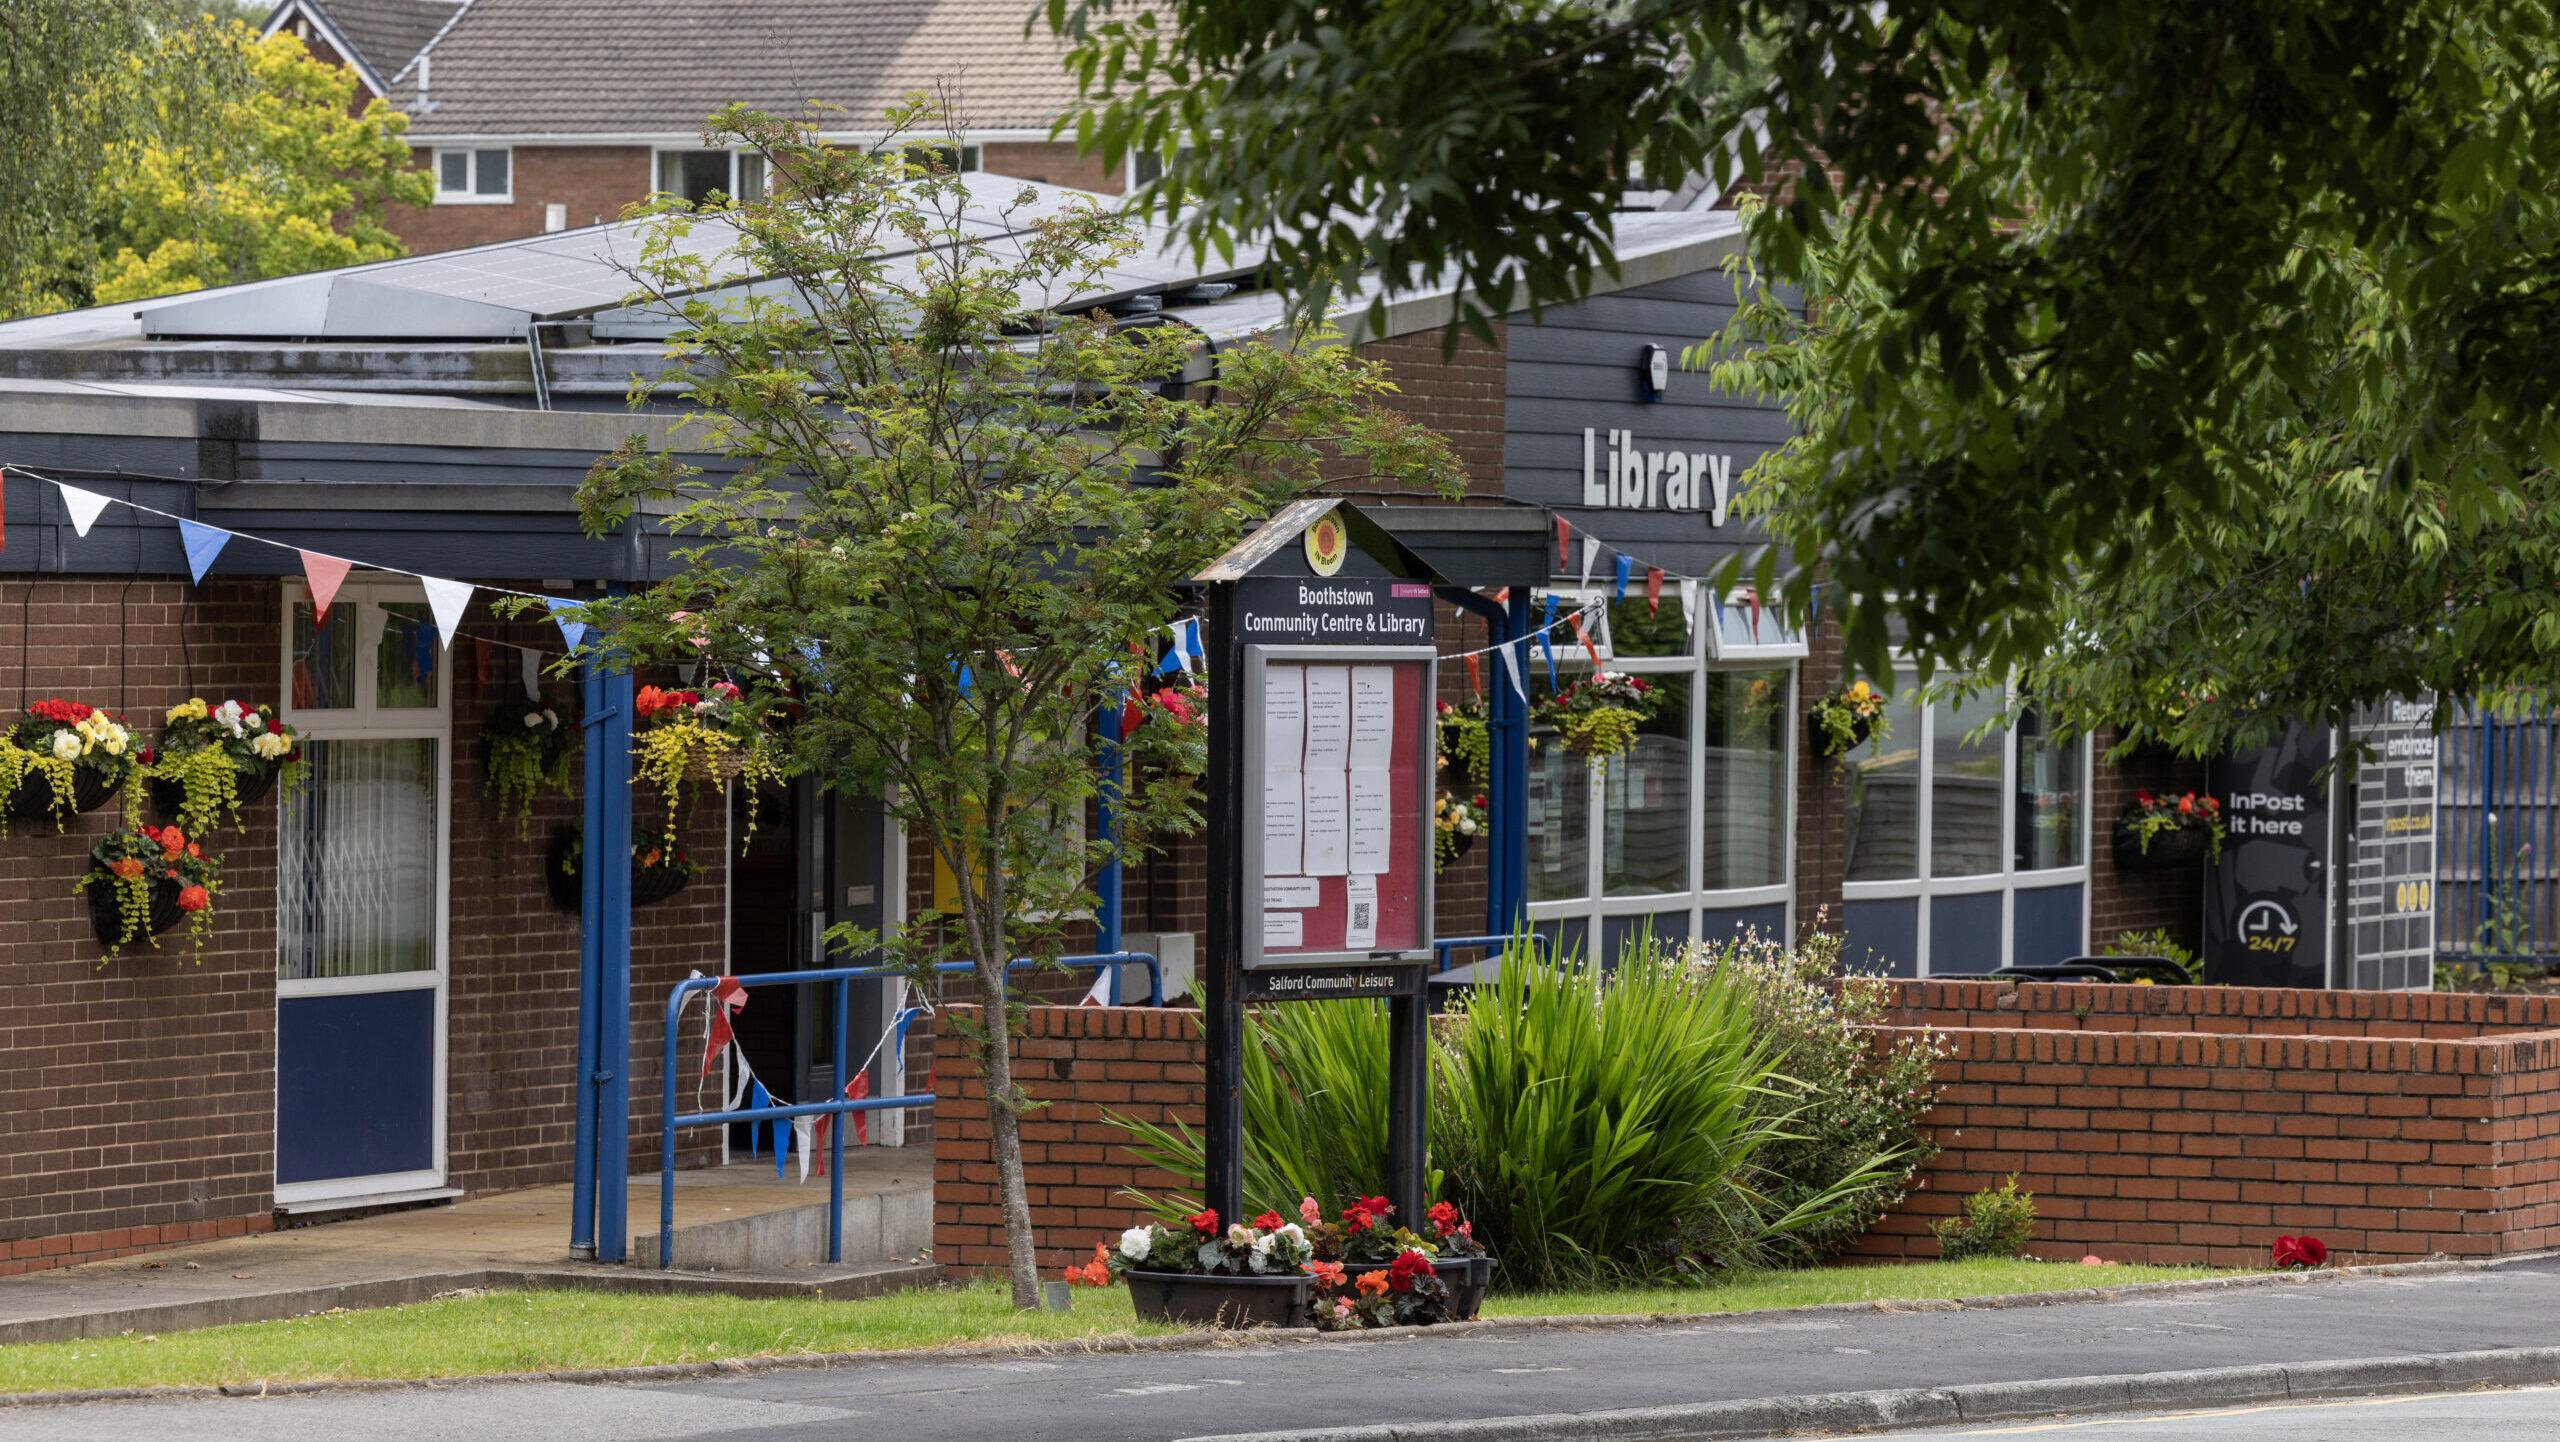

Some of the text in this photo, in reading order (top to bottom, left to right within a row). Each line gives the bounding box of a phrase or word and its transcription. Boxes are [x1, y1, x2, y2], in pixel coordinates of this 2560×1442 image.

[1584, 427, 1731, 527] Library
[1320, 553, 1338, 565] Bloom
[1299, 586, 1373, 605] Boothstown
[1245, 612, 1425, 637] Community Centre & Library
[2388, 735, 2433, 757] embrace
[2404, 764, 2433, 787] them.
[2230, 792, 2305, 811] InPost
[2230, 815, 2303, 835] it here
[2249, 936, 2295, 953] 24/7
[1269, 973, 1394, 991] Salford Community Leisure
